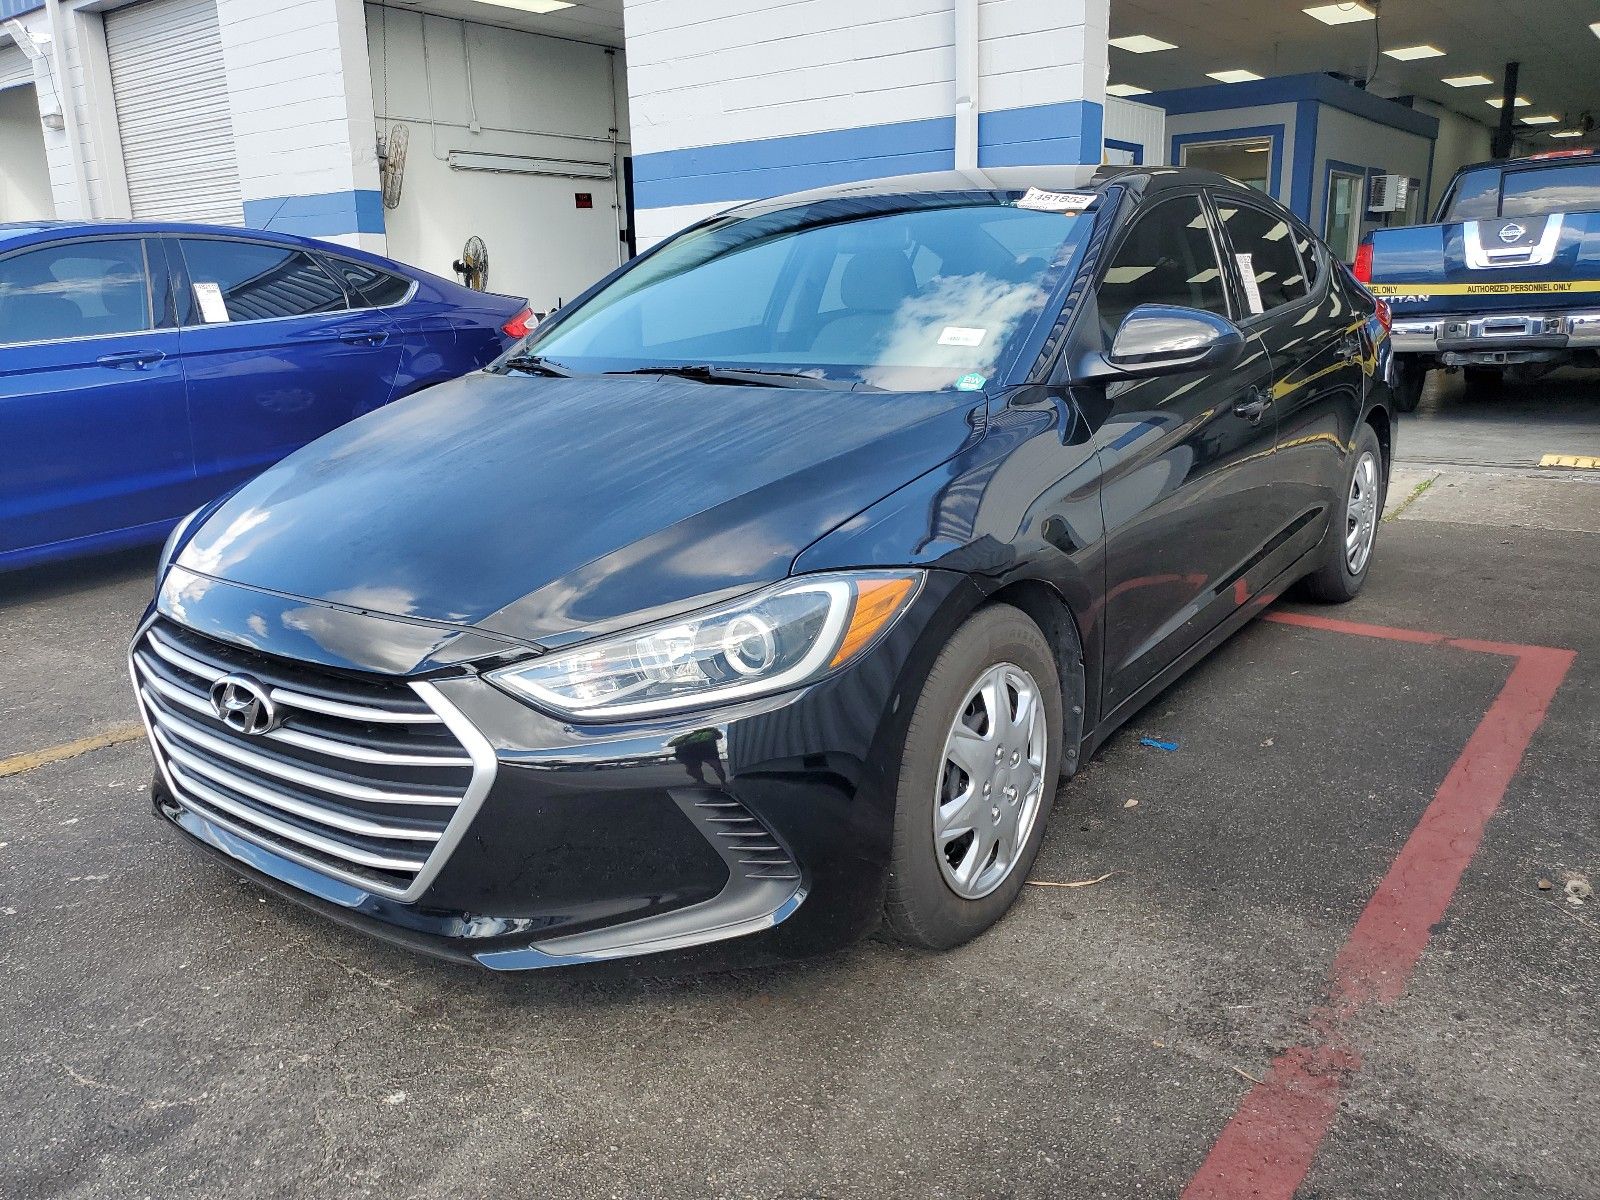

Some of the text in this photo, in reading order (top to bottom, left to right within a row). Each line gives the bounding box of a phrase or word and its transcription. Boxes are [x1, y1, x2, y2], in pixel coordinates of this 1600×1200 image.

[1382, 286, 1398, 294] ONLY
[1467, 282, 1572, 292] AUTHORIZED PERSONNEL ONLY
[1379, 295, 1430, 304] TITAN
